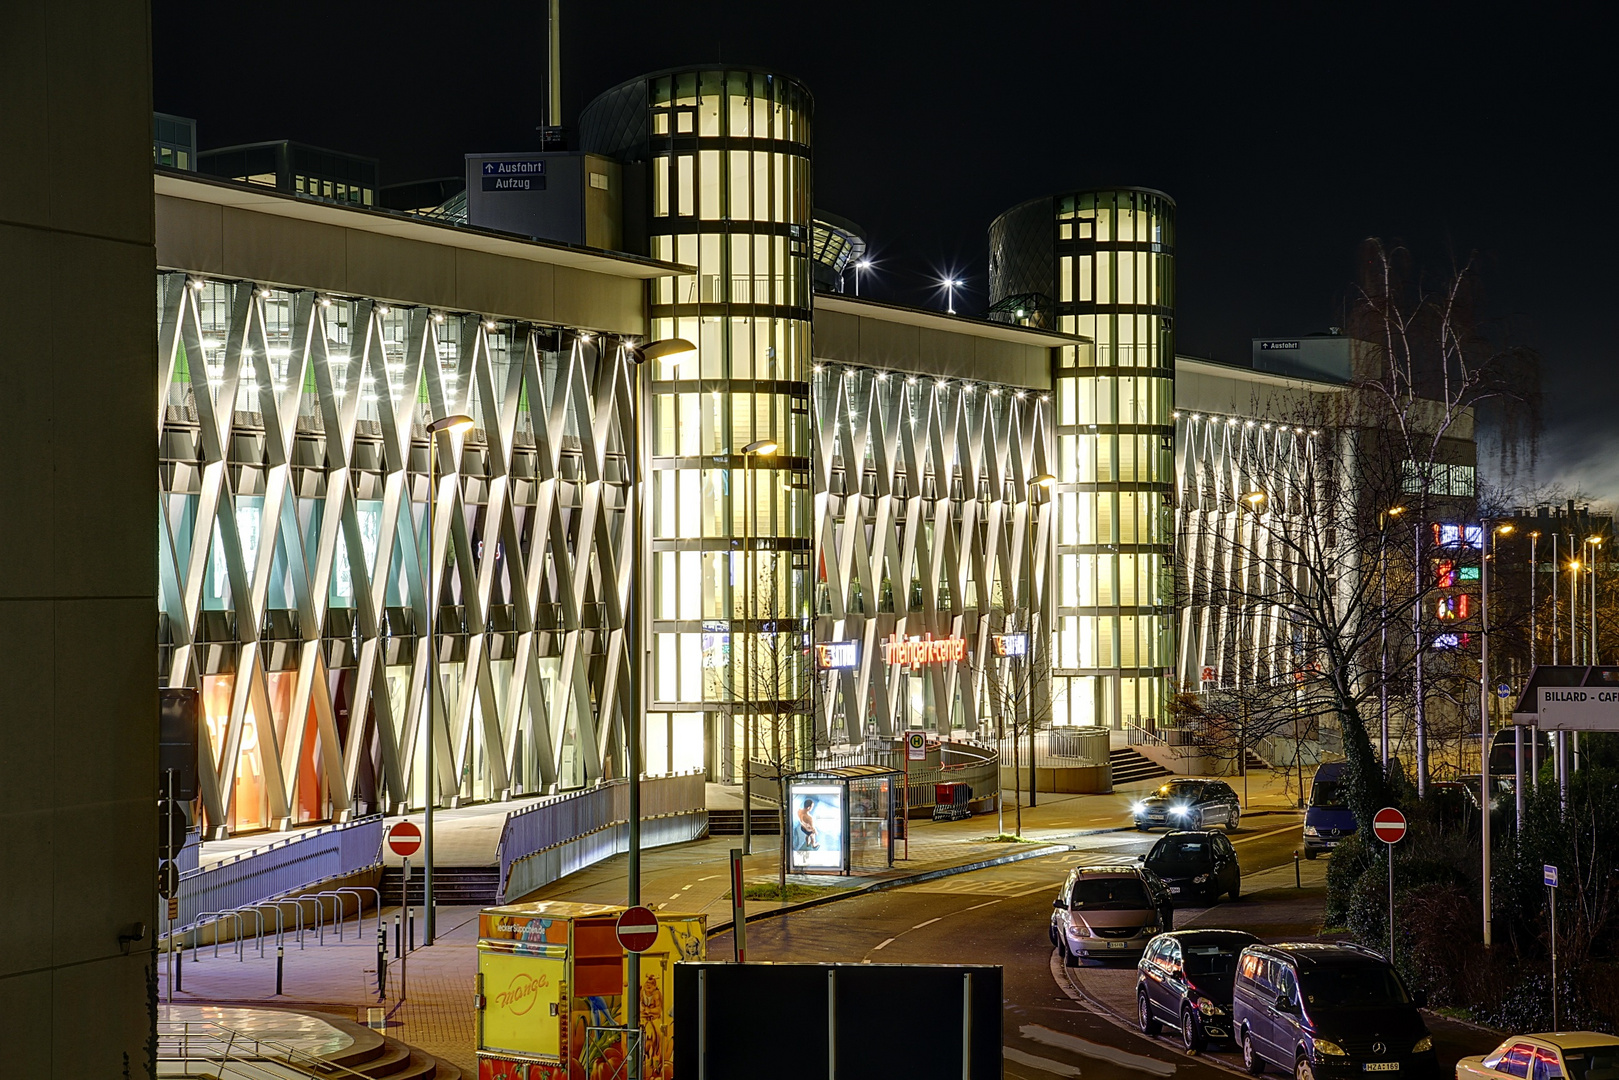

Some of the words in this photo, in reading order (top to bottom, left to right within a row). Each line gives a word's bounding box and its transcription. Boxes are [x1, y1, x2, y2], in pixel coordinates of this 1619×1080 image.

[498, 162, 542, 174] Ausfahrt
[495, 178, 531, 190] Aufzug
[886, 633, 966, 671] rheinpark-center
[1545, 692, 1587, 702] BILLARD
